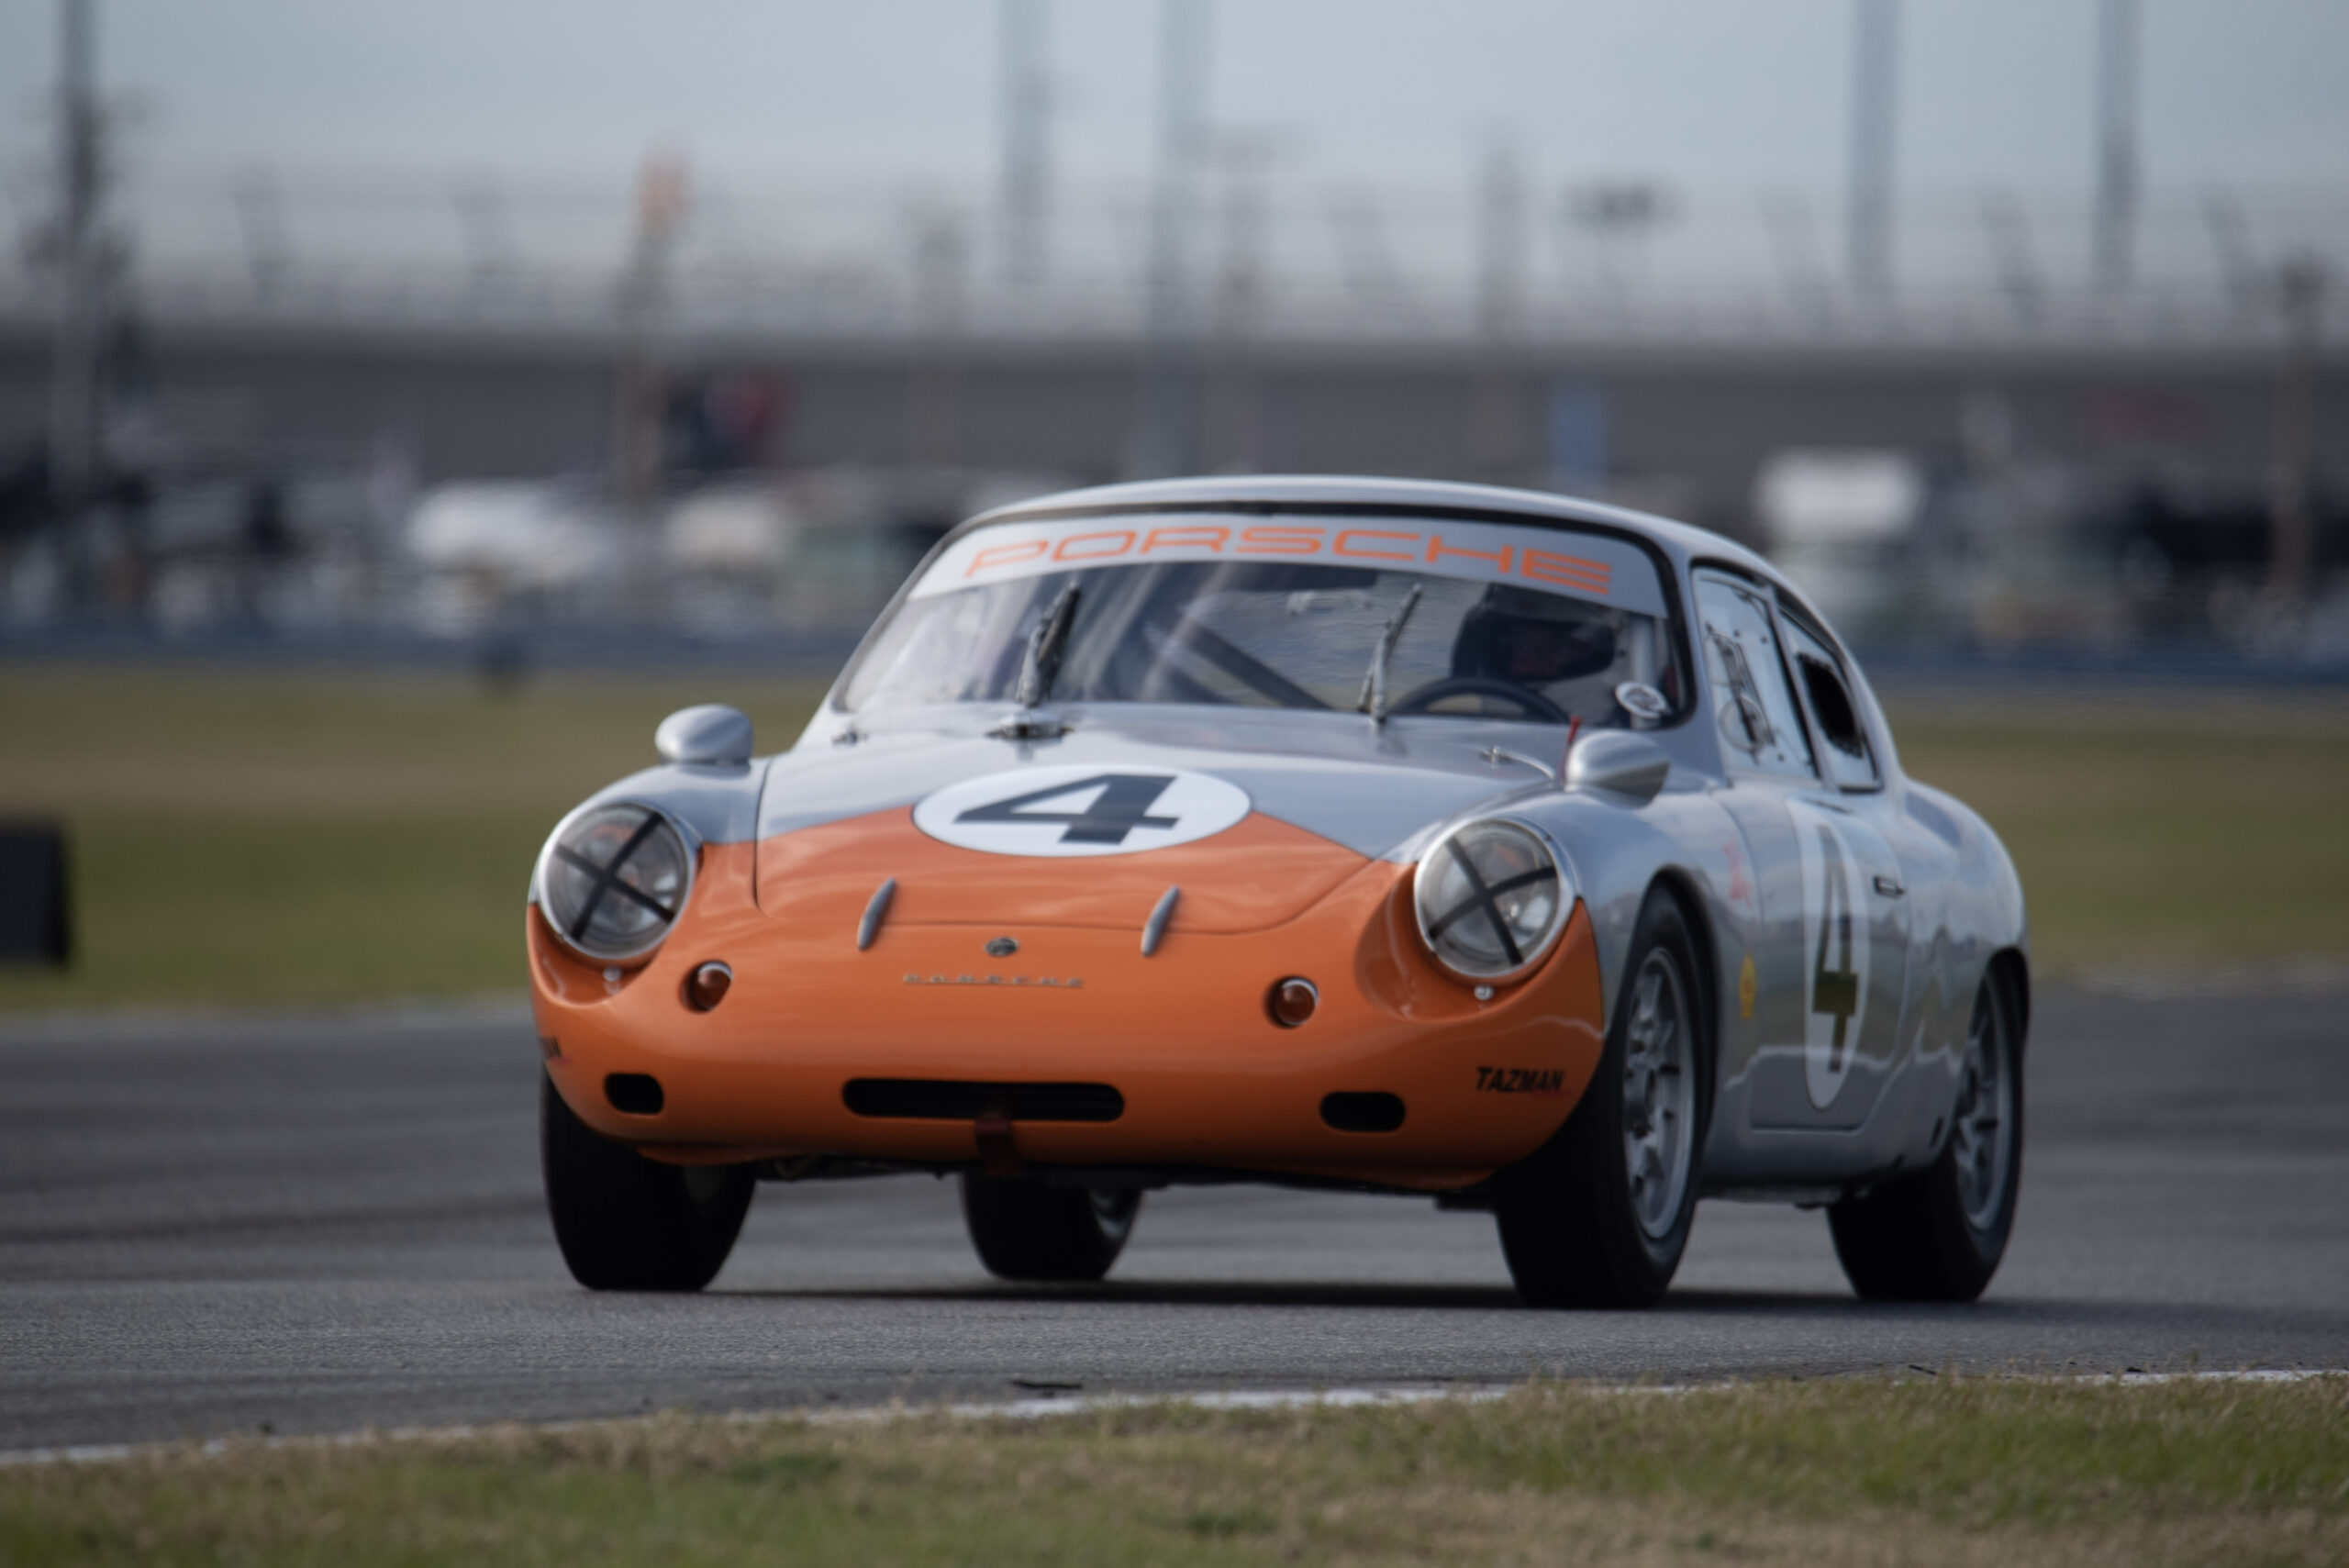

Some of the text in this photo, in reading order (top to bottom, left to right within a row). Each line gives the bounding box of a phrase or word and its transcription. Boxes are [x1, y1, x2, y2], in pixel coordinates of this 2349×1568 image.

[964, 526, 1612, 595] PORSCHE
[953, 773, 1181, 846] 4
[1812, 824, 1859, 1073] 4
[1476, 1066, 1565, 1093] TAZMAN
